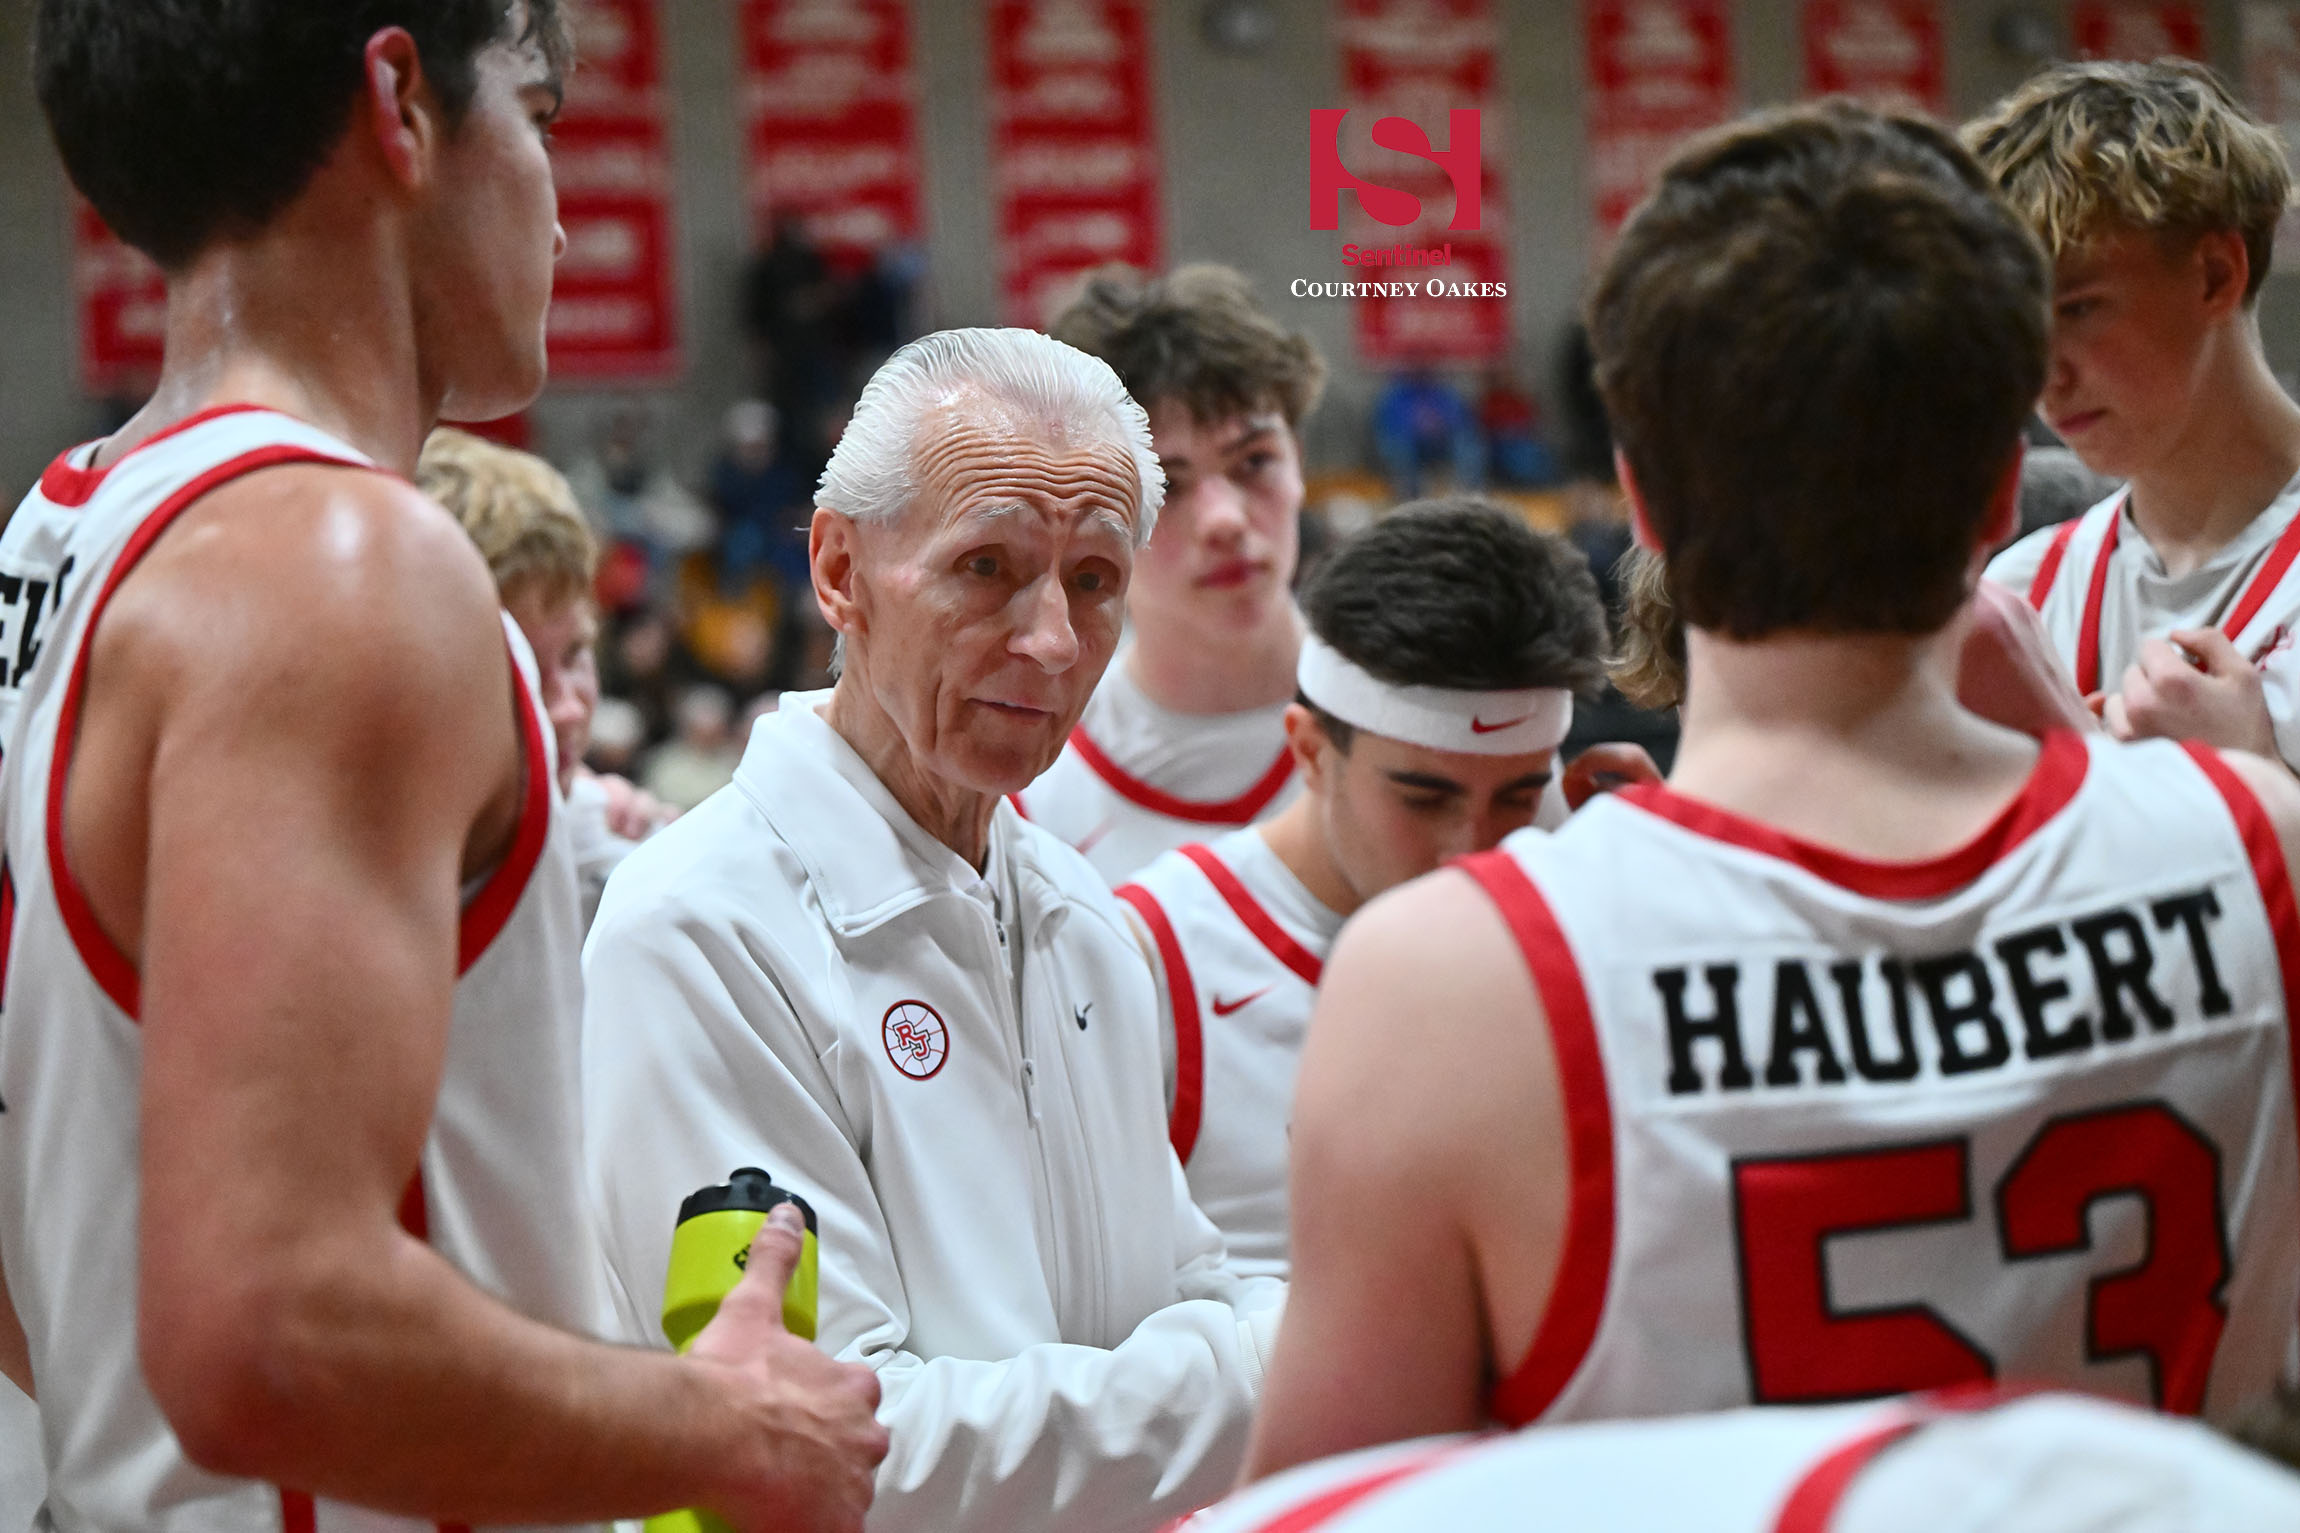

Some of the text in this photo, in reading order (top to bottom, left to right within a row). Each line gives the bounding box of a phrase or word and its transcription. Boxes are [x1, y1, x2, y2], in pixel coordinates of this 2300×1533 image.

[893, 1021, 930, 1060] RJ
[1652, 888, 2232, 1095] HAUBERT
[1731, 1099, 2231, 1416] 53
